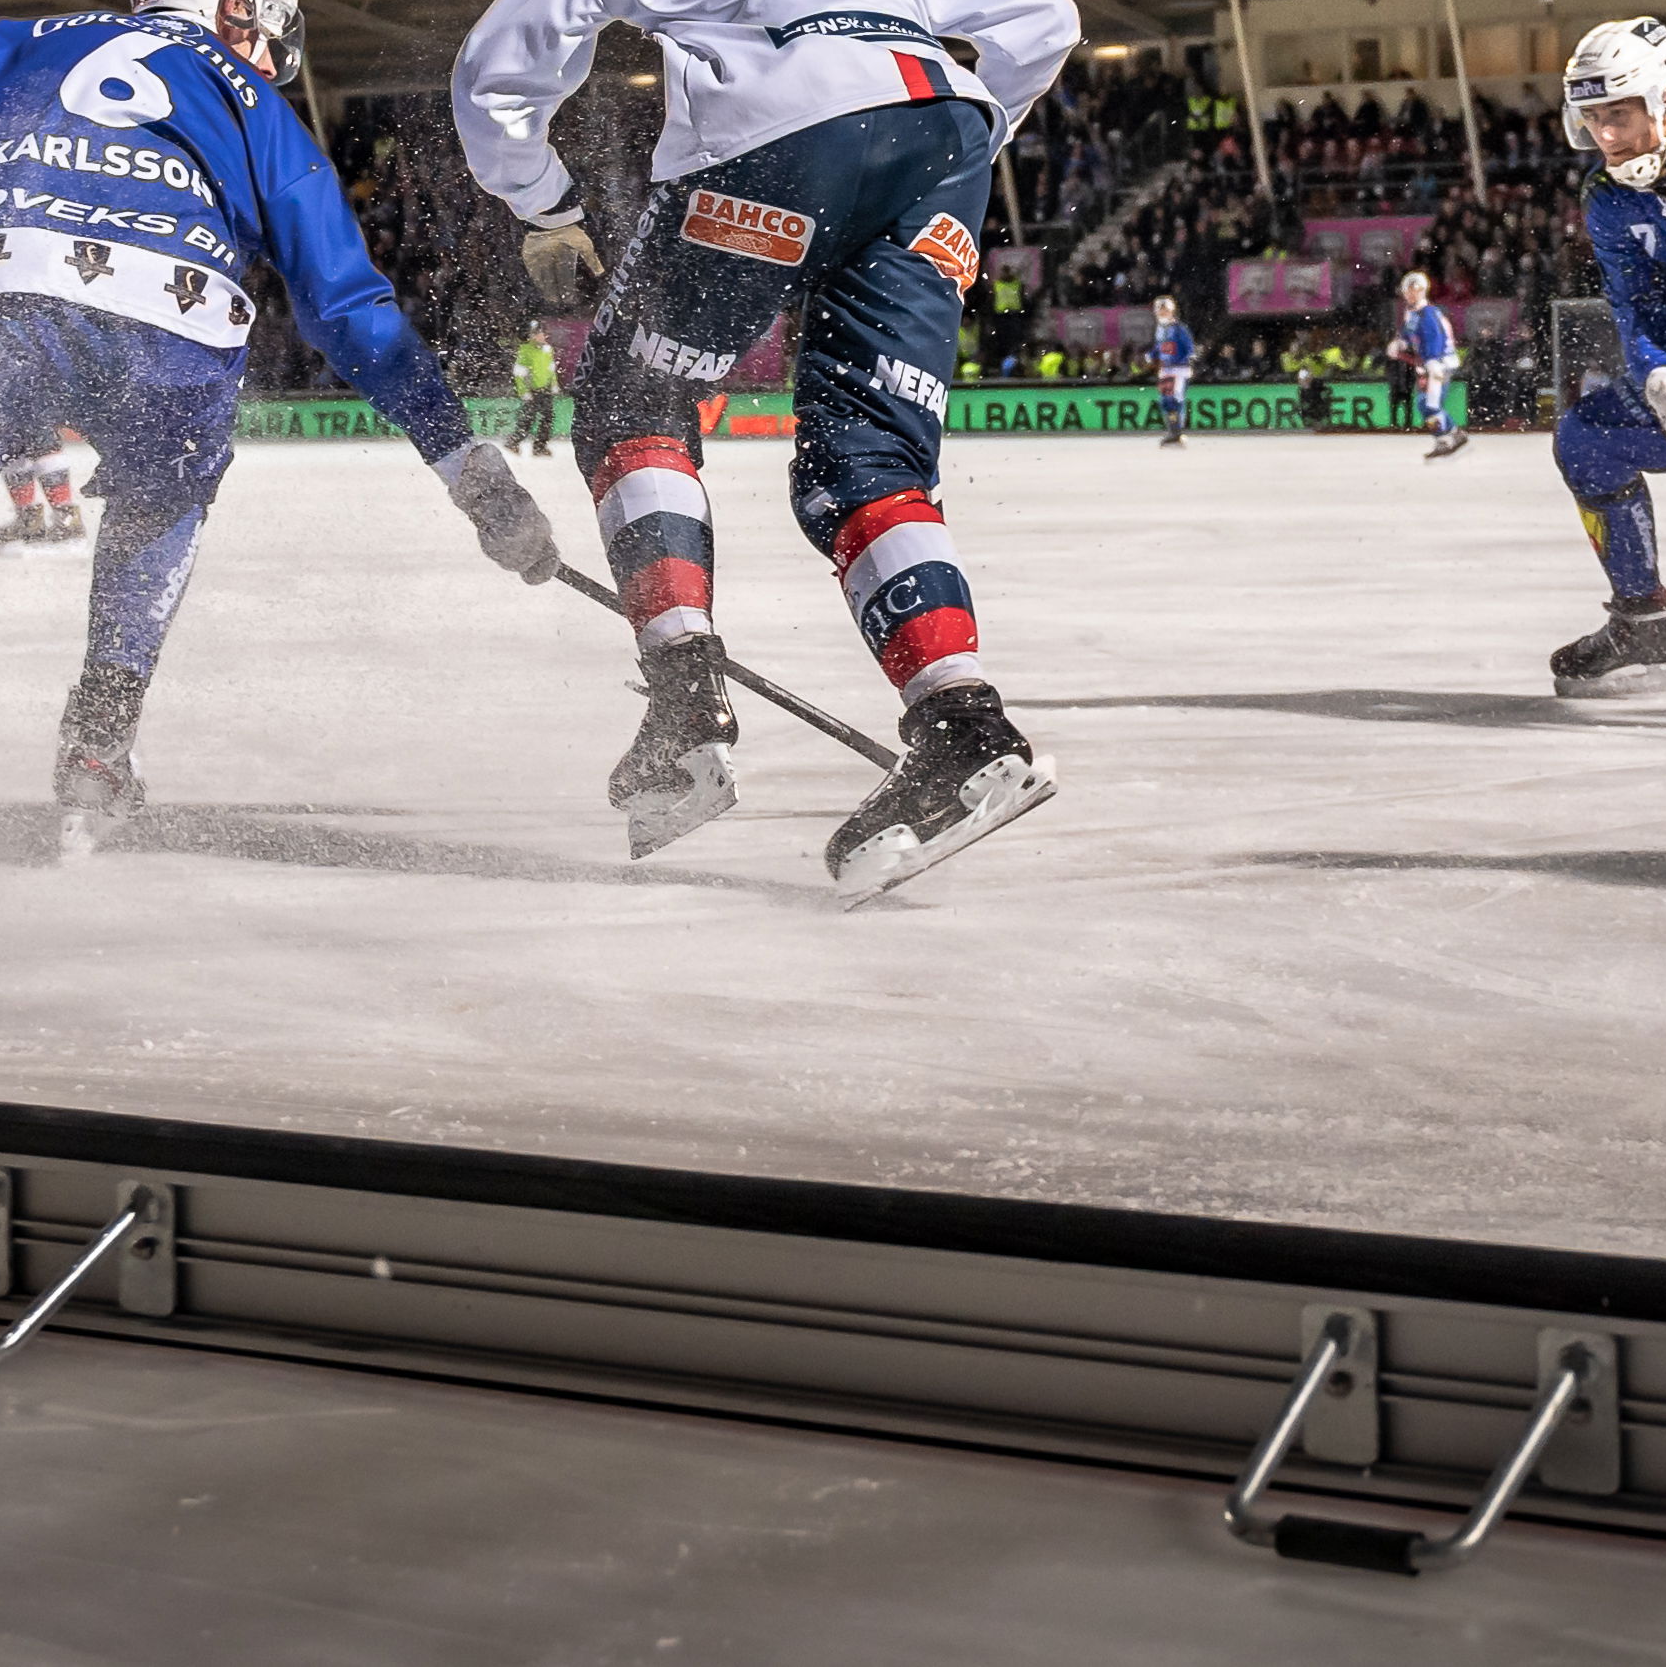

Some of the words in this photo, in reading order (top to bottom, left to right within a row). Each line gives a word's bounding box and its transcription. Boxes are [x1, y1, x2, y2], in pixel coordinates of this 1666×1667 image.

[60, 32, 174, 129] 6
[695, 192, 806, 238] BAHCO
[628, 323, 736, 382] NEFAB
